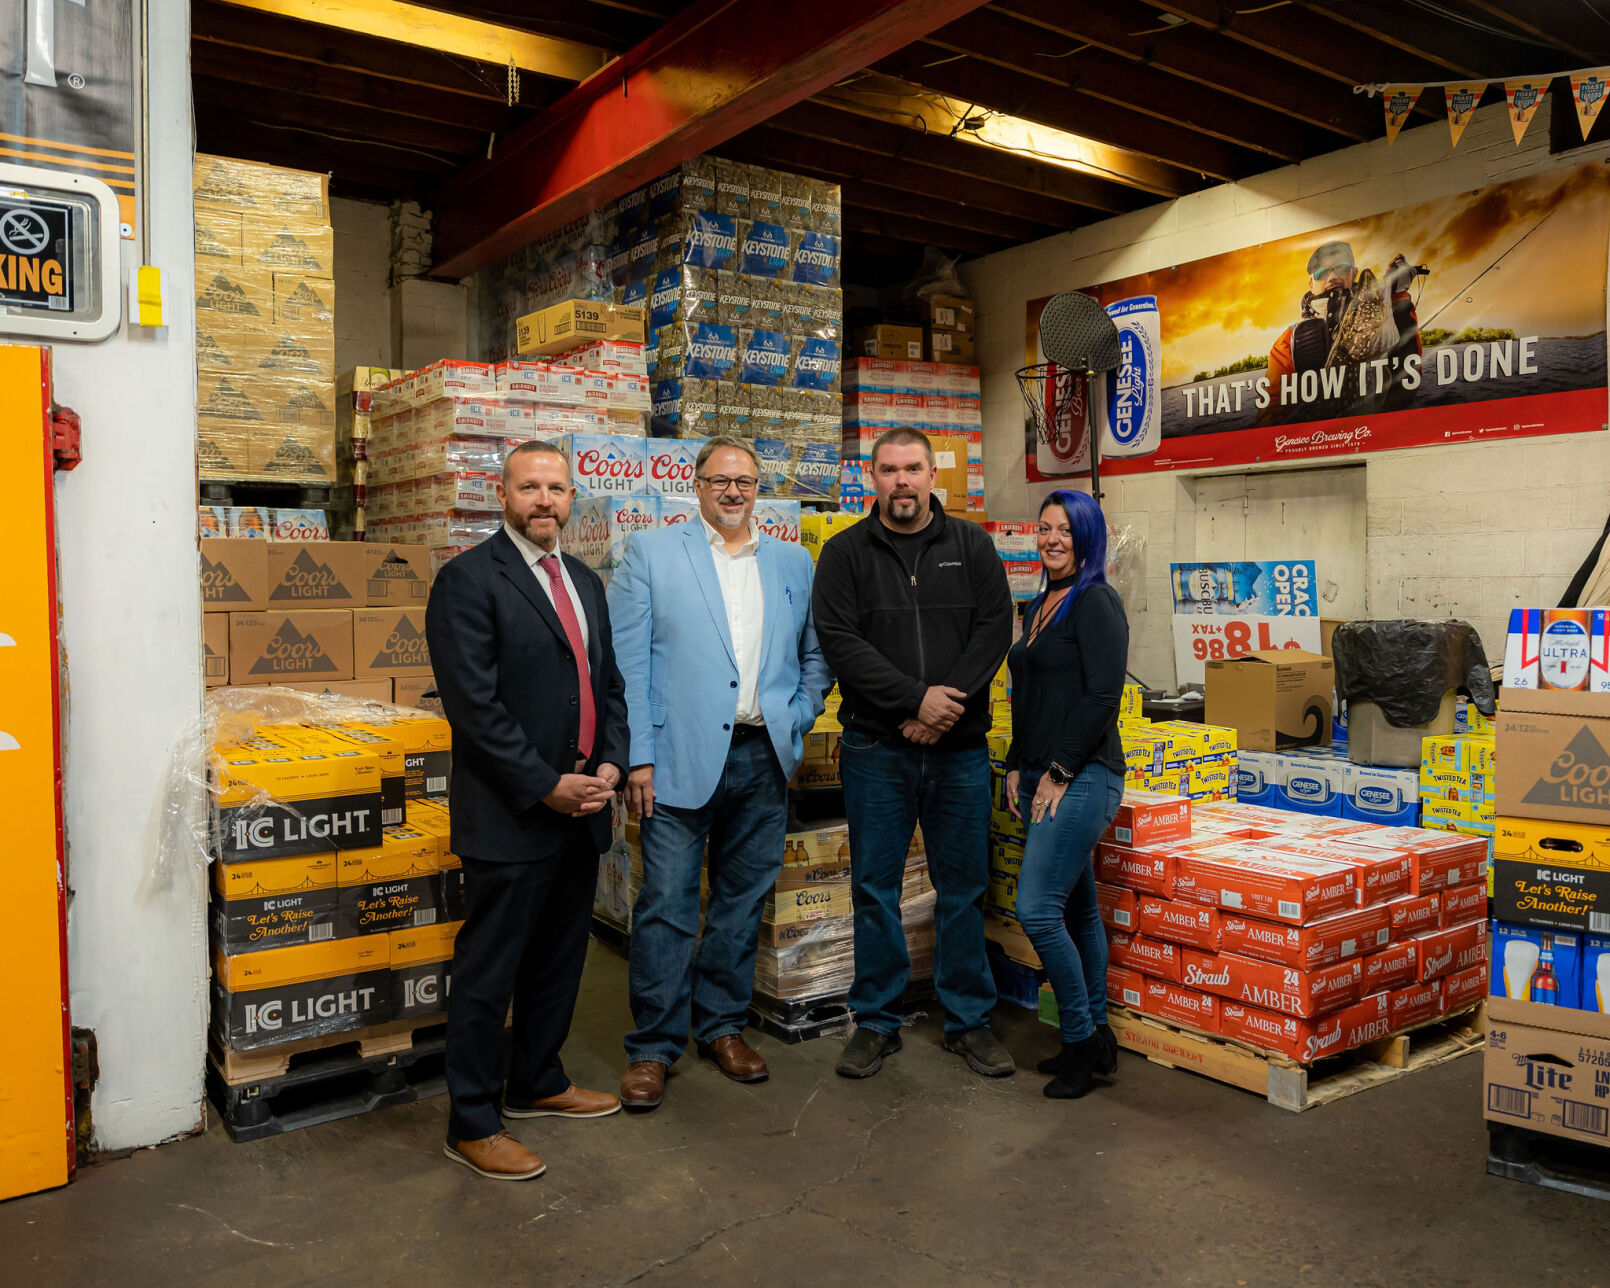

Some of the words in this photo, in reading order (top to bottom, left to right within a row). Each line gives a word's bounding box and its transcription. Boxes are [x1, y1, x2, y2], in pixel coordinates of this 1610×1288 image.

[685, 230, 736, 251] KEYSTONE
[741, 240, 791, 260] KEYSTONE
[575, 309, 599, 321] 5139
[686, 343, 737, 362] KEYSTONE
[741, 349, 791, 367] KEYSTONE
[795, 356, 840, 373] KEYSTONE
[1182, 376, 1270, 418] THAT'S
[1280, 365, 1346, 406] HOW
[1358, 353, 1422, 397] IT'S
[1437, 335, 1539, 387] DONE
[1116, 341, 1133, 438] GENESEE
[1131, 366, 1144, 407] Light
[1275, 434, 1311, 453] Genesee
[1311, 430, 1354, 444] Brewing
[1354, 426, 1372, 440] Co.
[577, 449, 645, 479] Coors
[650, 454, 696, 481] Coo
[795, 461, 841, 477] KEYSTONE
[589, 477, 634, 491] LIGHT
[662, 480, 695, 493] LIGH
[616, 508, 653, 524] Coors
[276, 521, 330, 540] Coors
[578, 515, 611, 543] Coors
[583, 542, 605, 556] LIGHT
[284, 564, 339, 586] Coors
[291, 585, 331, 598] LIGHT
[1292, 563, 1311, 617] CRAC
[263, 635, 325, 660] Coors
[1542, 647, 1588, 658] ULTRA
[273, 658, 314, 671] LIGHT
[1514, 677, 1528, 686] 2.6
[405, 758, 425, 767] GHT
[1544, 750, 1610, 787] Coo
[1149, 781, 1168, 792] TWISTED
[1169, 781, 1177, 789] TEA
[1291, 780, 1320, 791] GENESEE
[1433, 775, 1456, 783] TWISTED
[1456, 776, 1467, 785] TEA
[1360, 790, 1391, 800] GENESEE
[1560, 784, 1610, 804] LIGH
[1153, 812, 1179, 827] AMBER
[1432, 807, 1452, 815] TWISTED
[1452, 808, 1462, 817] TEA
[235, 817, 274, 850] IC
[283, 809, 370, 841] LIGHT
[1502, 829, 1512, 837] 24
[1121, 860, 1152, 877] AMBER
[1536, 869, 1551, 881] IC
[1553, 872, 1585, 884] LIGHT
[372, 886, 384, 897] IC
[385, 884, 409, 894] LIGHT
[796, 889, 831, 907] Coors
[1515, 880, 1551, 896] Let's
[1555, 885, 1597, 903] Raise
[263, 900, 276, 911] IC
[277, 898, 302, 908] LIGHT
[358, 898, 387, 911] Let's
[388, 895, 419, 908] Raise
[1516, 896, 1589, 916] Another!
[247, 912, 279, 926] Let's
[281, 909, 314, 923] Raise
[360, 906, 413, 925] Another!
[1143, 903, 1162, 914] Straub
[1163, 910, 1197, 928] AMBER
[1198, 911, 1209, 923] 24
[249, 921, 308, 941] Another!
[1225, 919, 1246, 931] Straub
[1247, 927, 1285, 946] AMBER
[1287, 928, 1299, 941] 24
[1111, 934, 1128, 945] Straub
[1129, 942, 1161, 960] AMBER
[1163, 944, 1173, 956] 24
[1456, 944, 1486, 968] AMBER
[1283, 969, 1299, 987] 24
[404, 975, 438, 1008] IC
[1149, 984, 1167, 995] Straub
[1168, 993, 1200, 1011] AMBER
[1184, 963, 1230, 986] Straub
[1240, 983, 1304, 1015] AMBER
[245, 1000, 283, 1033] IC
[291, 987, 375, 1023] LIGHT
[1201, 995, 1212, 1007] 24
[1377, 995, 1387, 1011] 24
[1224, 1005, 1244, 1017] Straub
[1245, 1015, 1282, 1036] AMBER
[1284, 1019, 1297, 1032] 24
[1303, 1019, 1342, 1060] Straub
[1347, 1018, 1390, 1046] AMBER
[1490, 1030, 1507, 1040] 4-6
[1524, 1062, 1573, 1091] Lite
